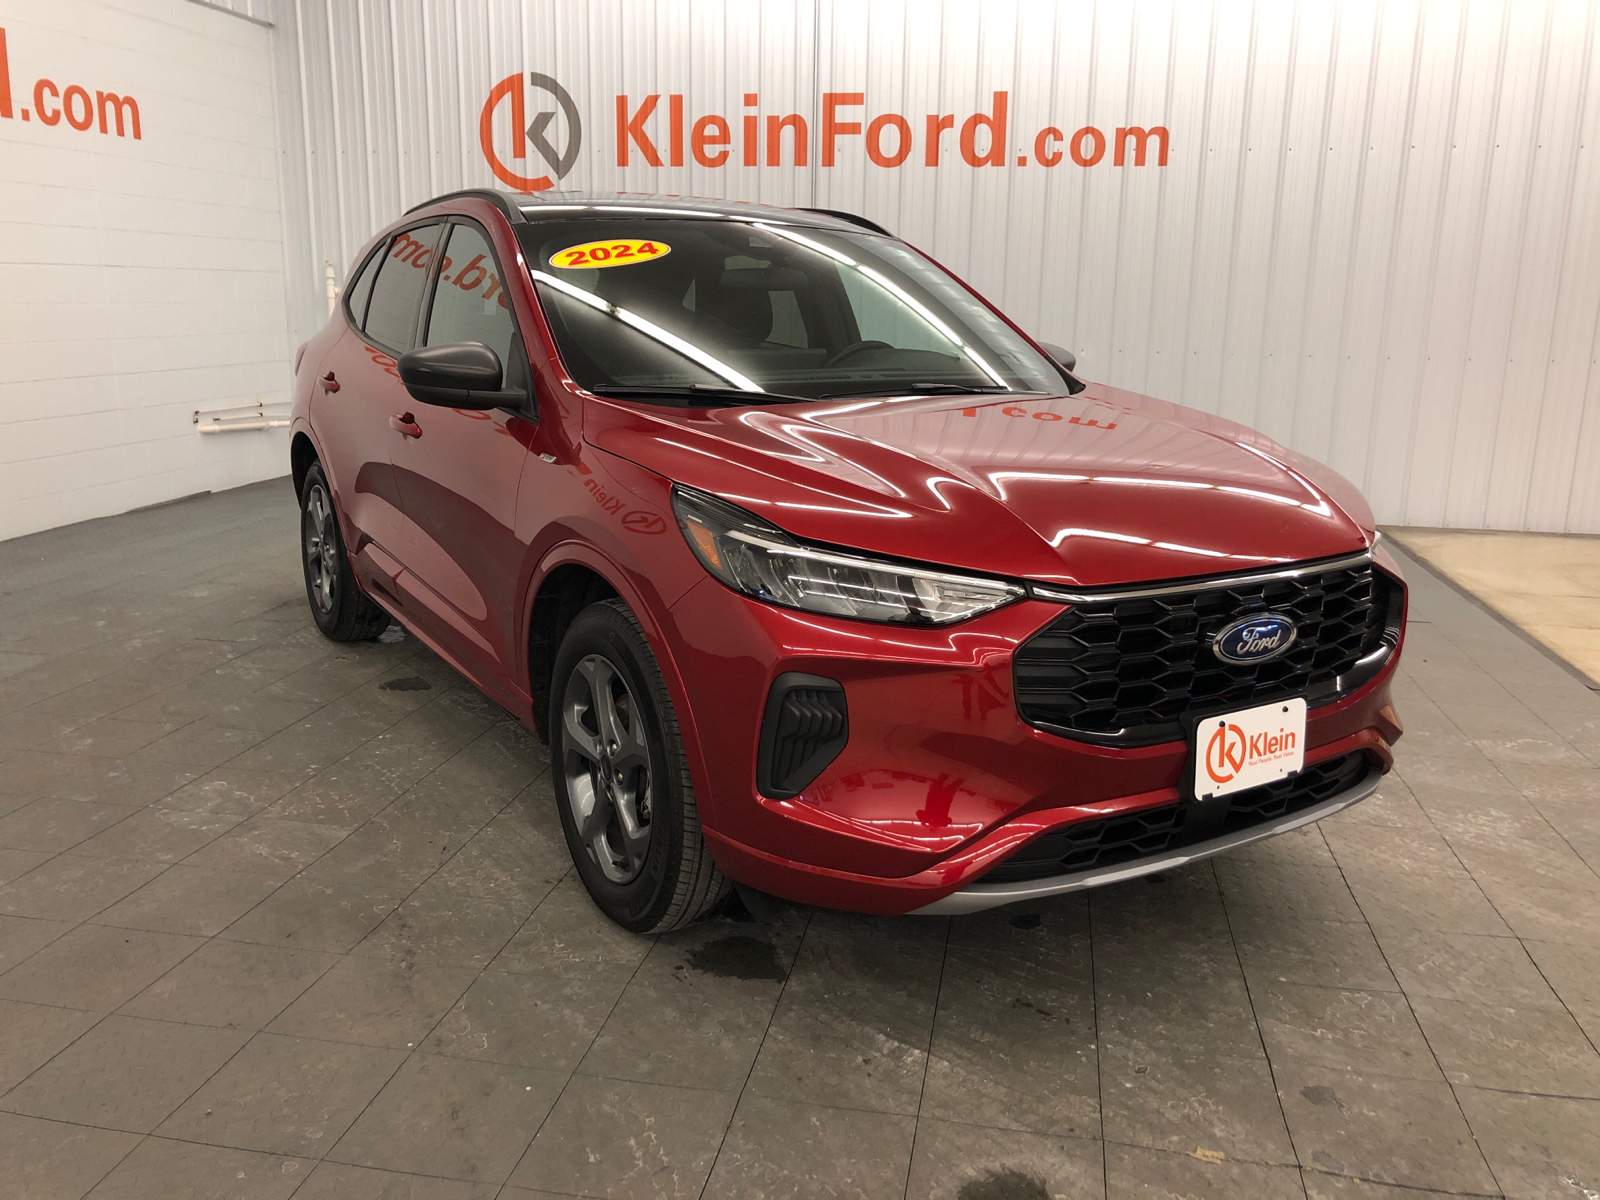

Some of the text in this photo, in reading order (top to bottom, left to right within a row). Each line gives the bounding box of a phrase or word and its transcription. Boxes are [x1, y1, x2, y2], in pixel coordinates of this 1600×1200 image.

[0, 27, 141, 140] .com
[616, 91, 1169, 168] KleinFord.com
[565, 242, 659, 266] 2024
[1236, 627, 1281, 655] Ford
[1249, 727, 1296, 760] Klein
